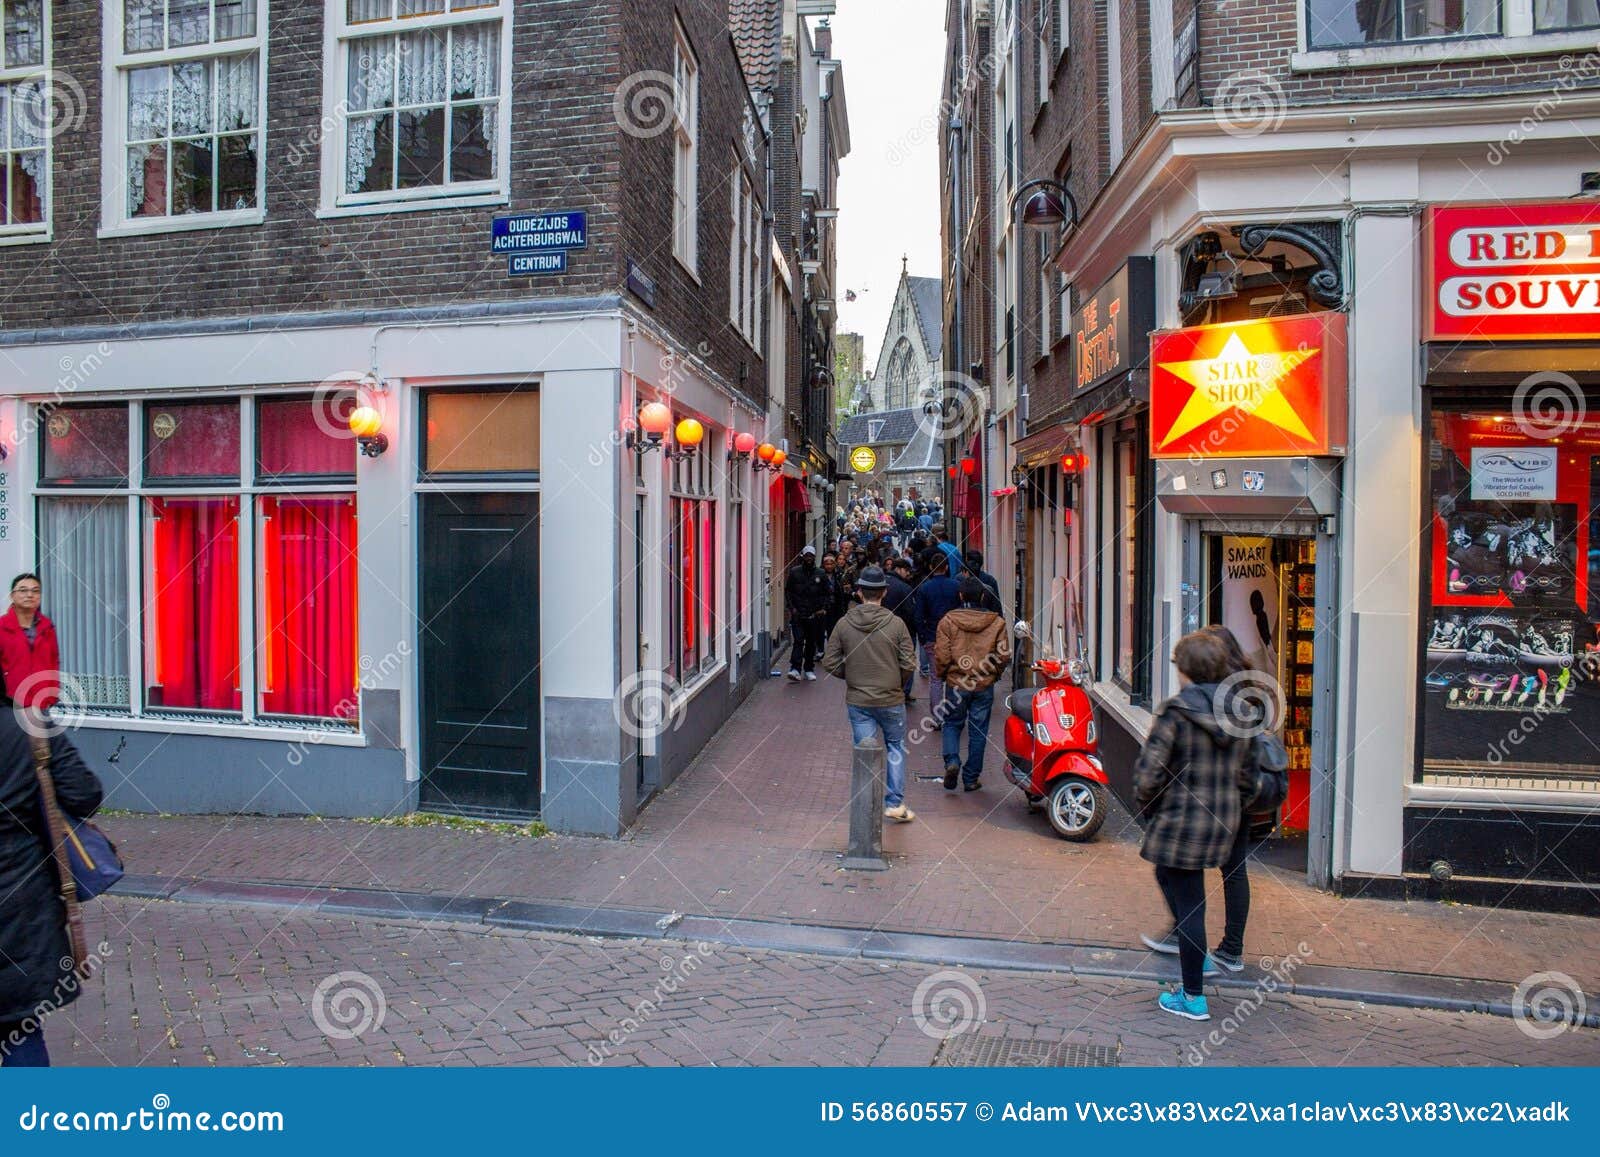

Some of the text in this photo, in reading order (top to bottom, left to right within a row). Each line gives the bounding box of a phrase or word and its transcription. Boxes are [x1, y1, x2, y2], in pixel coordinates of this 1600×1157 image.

[508, 216, 569, 232] OUDEZIJDS
[494, 230, 584, 249] ACHTERBURGWAL
[1467, 231, 1567, 260] RED
[514, 256, 561, 271] CENTRUM
[1083, 298, 1098, 337] THE
[1077, 297, 1120, 388] DISTRICT
[1208, 359, 1260, 381] STAR
[1208, 383, 1261, 403] SHOP
[1227, 546, 1267, 562] SMART
[1227, 564, 1267, 579] WANDS
